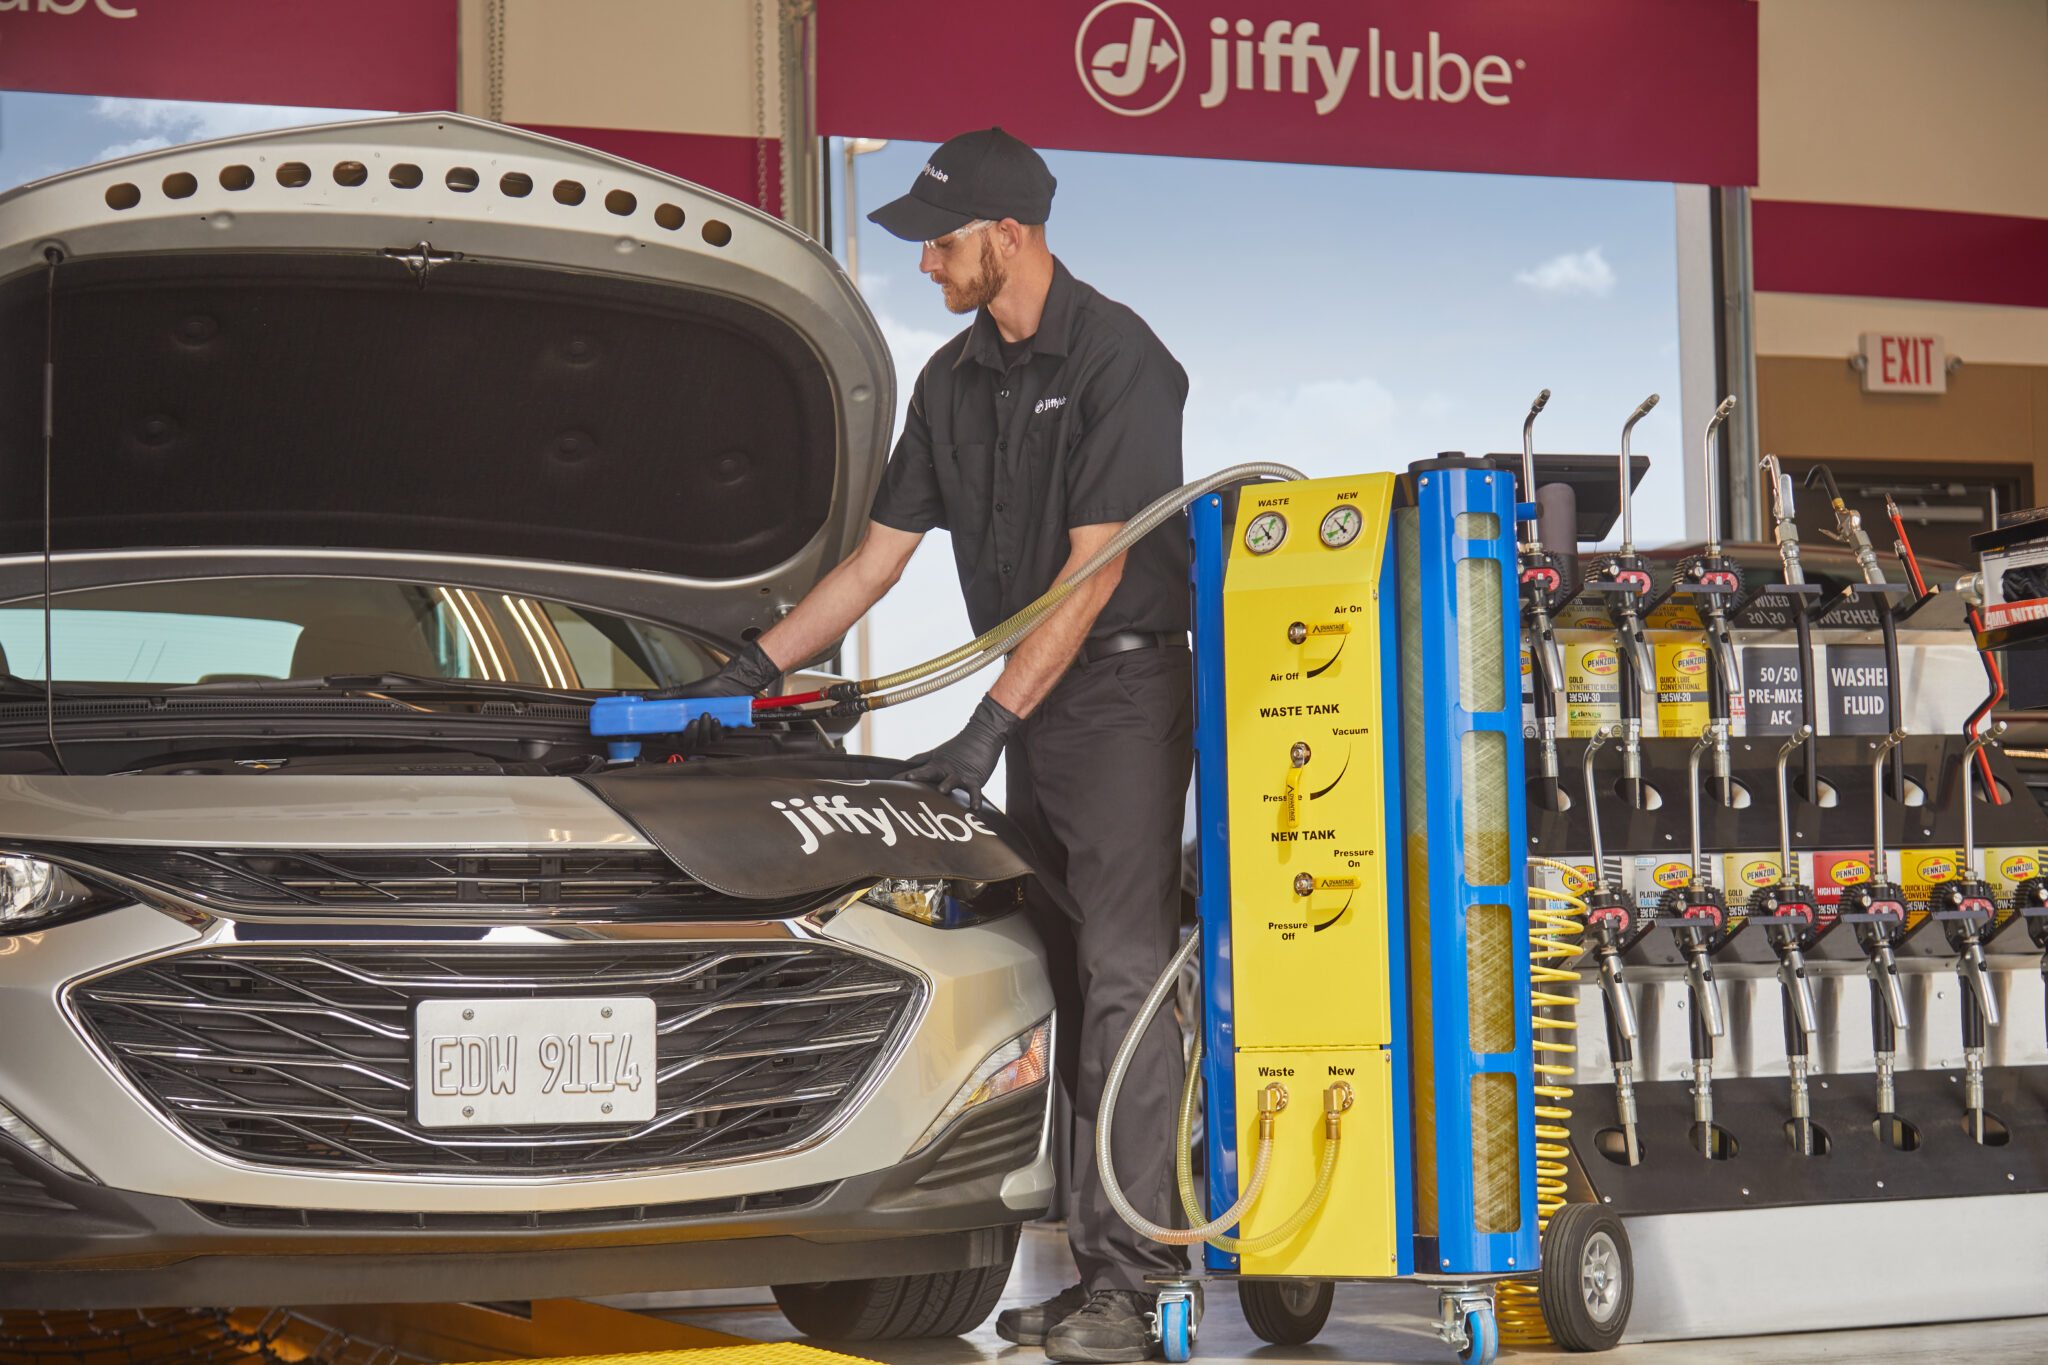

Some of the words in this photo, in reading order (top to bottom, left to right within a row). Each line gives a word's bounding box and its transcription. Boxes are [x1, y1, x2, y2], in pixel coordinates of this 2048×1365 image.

[1881, 336, 1934, 385] EXIT
[1337, 492, 1358, 500] NEW
[1258, 498, 1289, 507] WASTE
[1350, 605, 1362, 613] On
[1588, 656, 1616, 667] PENNZOIL
[1678, 656, 1707, 668] PENNZOIL
[1286, 672, 1299, 680] Off
[1568, 676, 1584, 684] GOLD
[1760, 666, 1798, 685] 50/50
[1660, 683, 1700, 691] CONVENTIONAL
[1577, 692, 1600, 703] 5W-30
[1669, 692, 1691, 703] 5W-20
[1748, 688, 1803, 704] PRE-MIXE
[1260, 706, 1303, 718] WASTE
[1306, 704, 1340, 715] TANK
[1843, 696, 1885, 715] FLUID
[1770, 710, 1793, 725] AFC
[1332, 727, 1369, 736] Vacuum
[1263, 794, 1303, 802] Presse
[1271, 832, 1299, 842] NEW
[1302, 830, 1336, 841] TANK
[1333, 848, 1374, 857] Pressure
[1348, 860, 1360, 868] On
[2006, 863, 2033, 874] PENNZOIL
[1659, 870, 1689, 882] PENNZOIL
[1747, 868, 1776, 880] PENNZOIL
[1836, 867, 1865, 879] PENNZOIL
[1923, 865, 1951, 876] PENNZOIL
[1549, 901, 1562, 910] FULL
[1268, 922, 1308, 930] Pressure
[1281, 933, 1296, 941] Off
[432, 1035, 517, 1095] EDW
[1328, 1066, 1355, 1075] New
[1258, 1067, 1295, 1076] Waste
